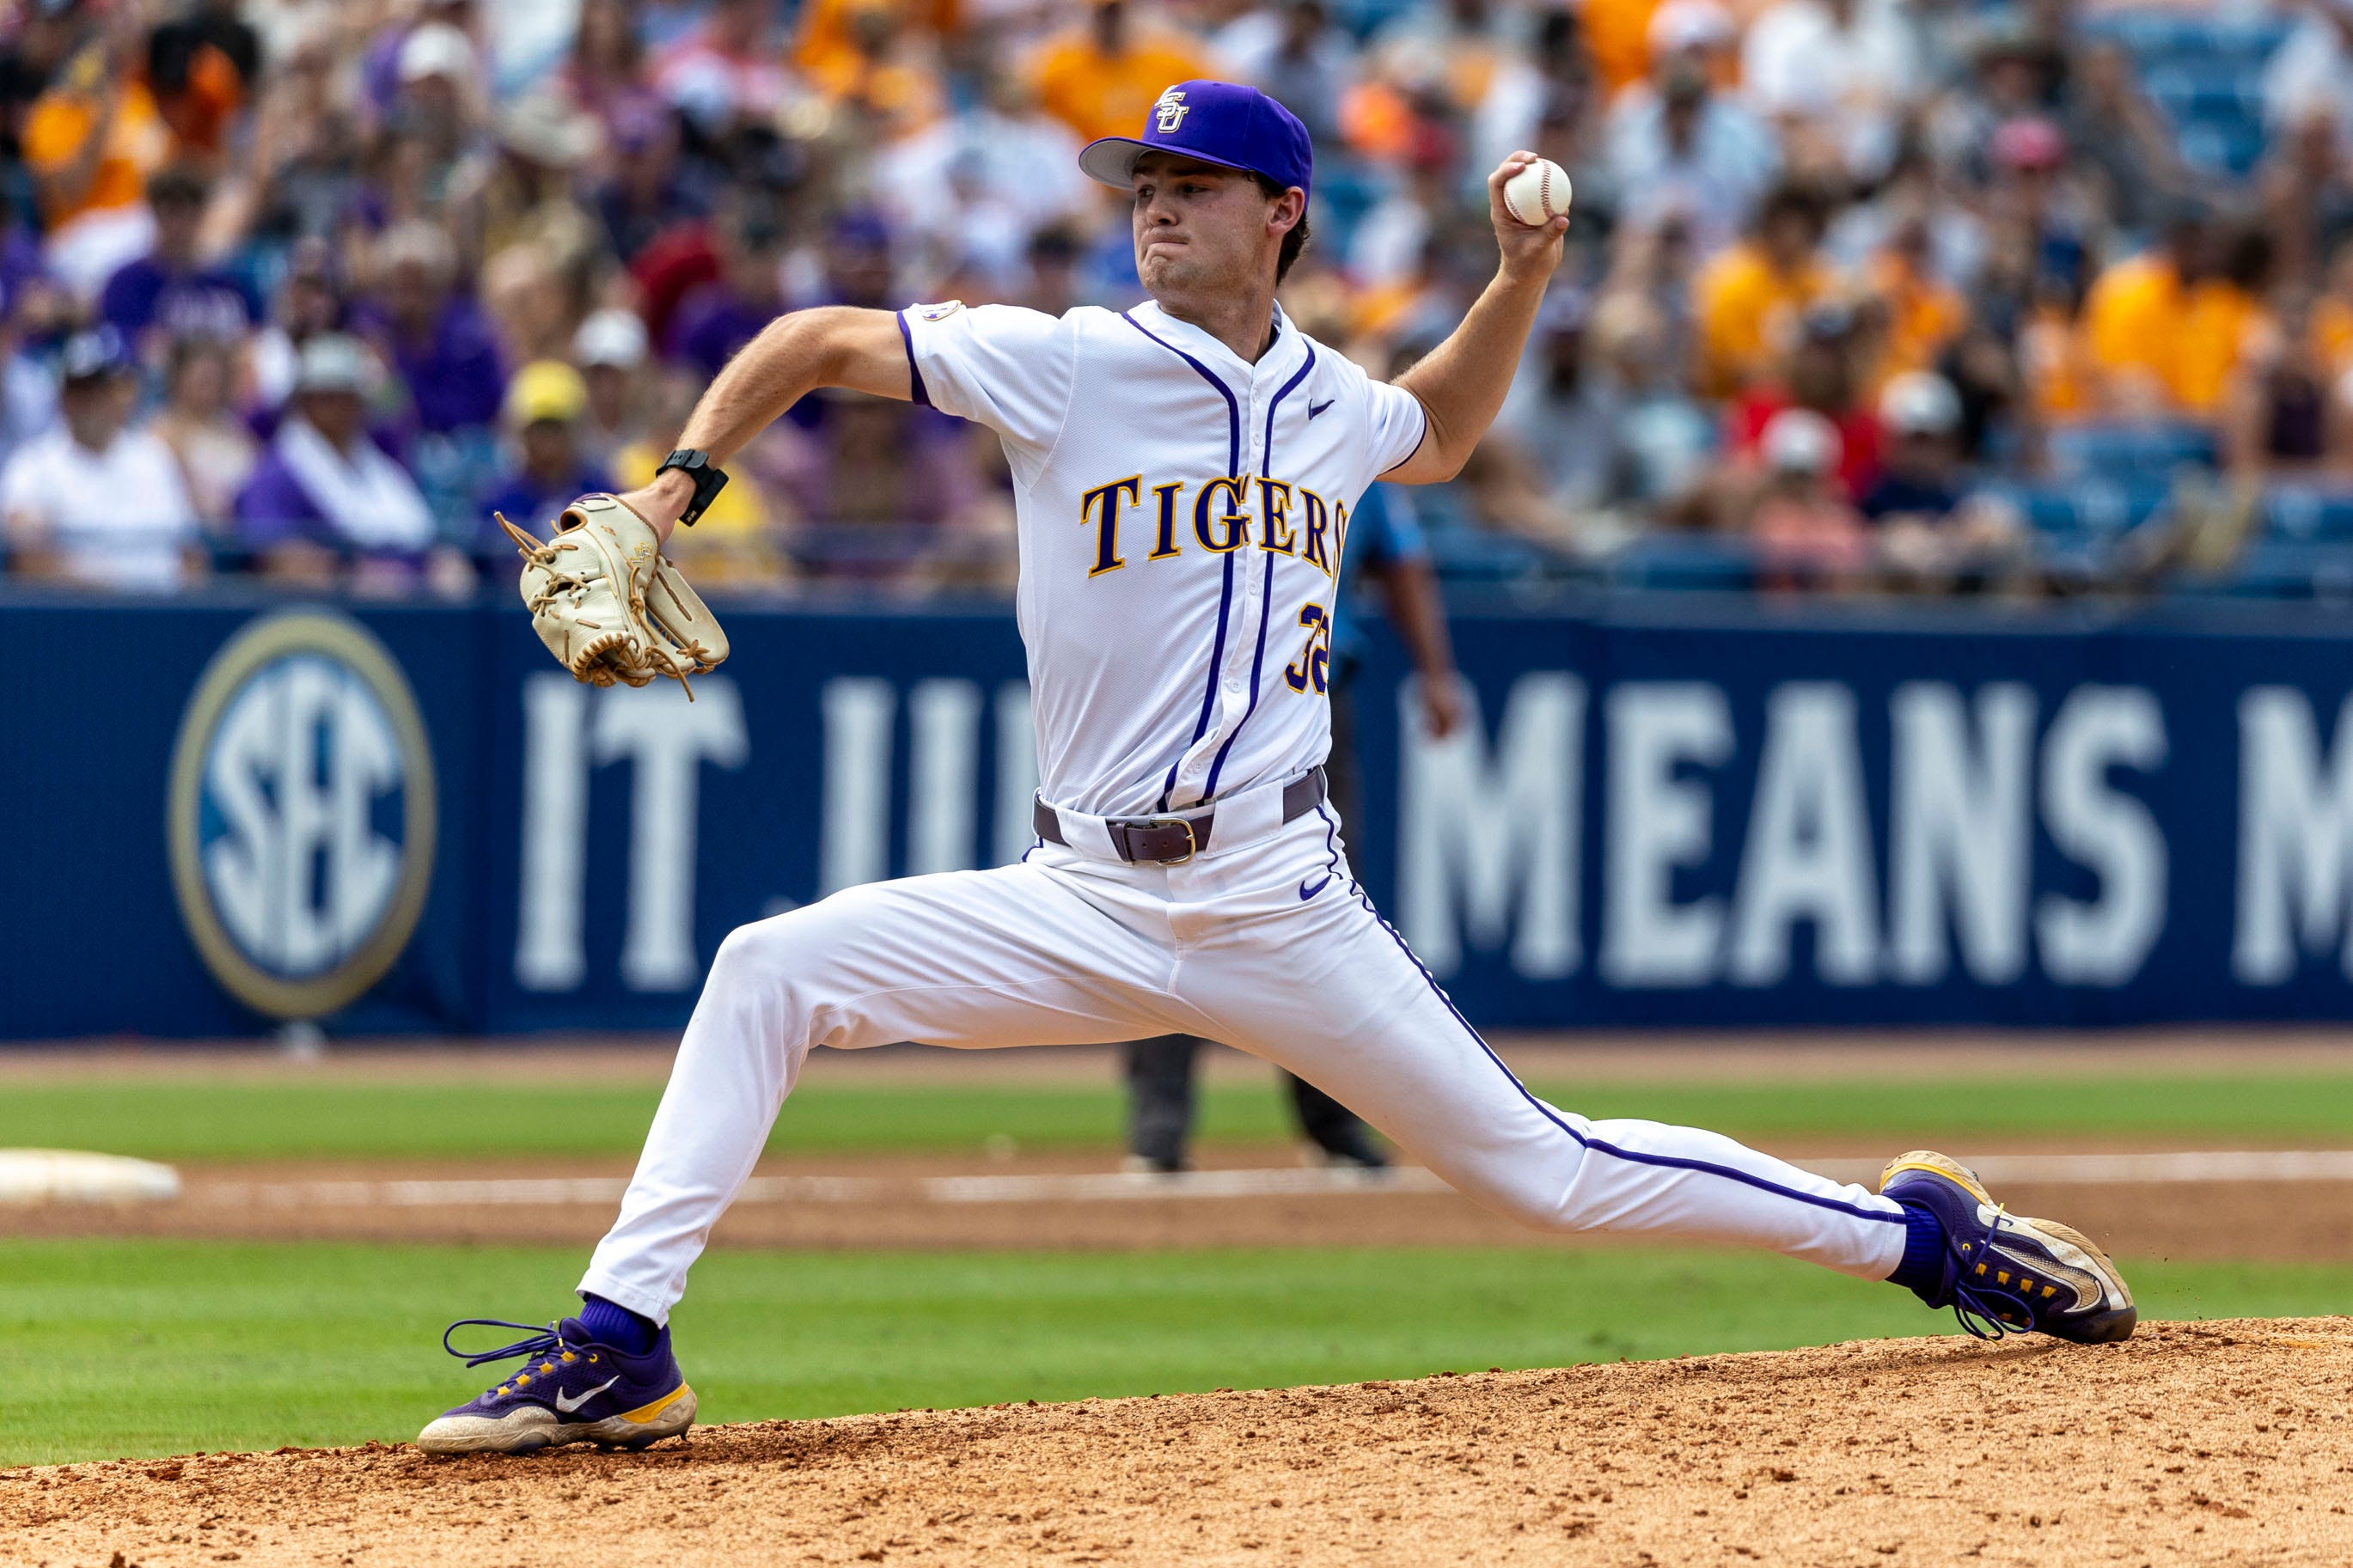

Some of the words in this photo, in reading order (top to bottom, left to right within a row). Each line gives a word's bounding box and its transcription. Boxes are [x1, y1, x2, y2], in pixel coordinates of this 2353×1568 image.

[1154, 85, 1189, 133] LSU
[1283, 601, 1331, 696] 32
[206, 660, 402, 976] SEC
[518, 675, 749, 989] IT
[1397, 672, 2169, 987] MEANS
